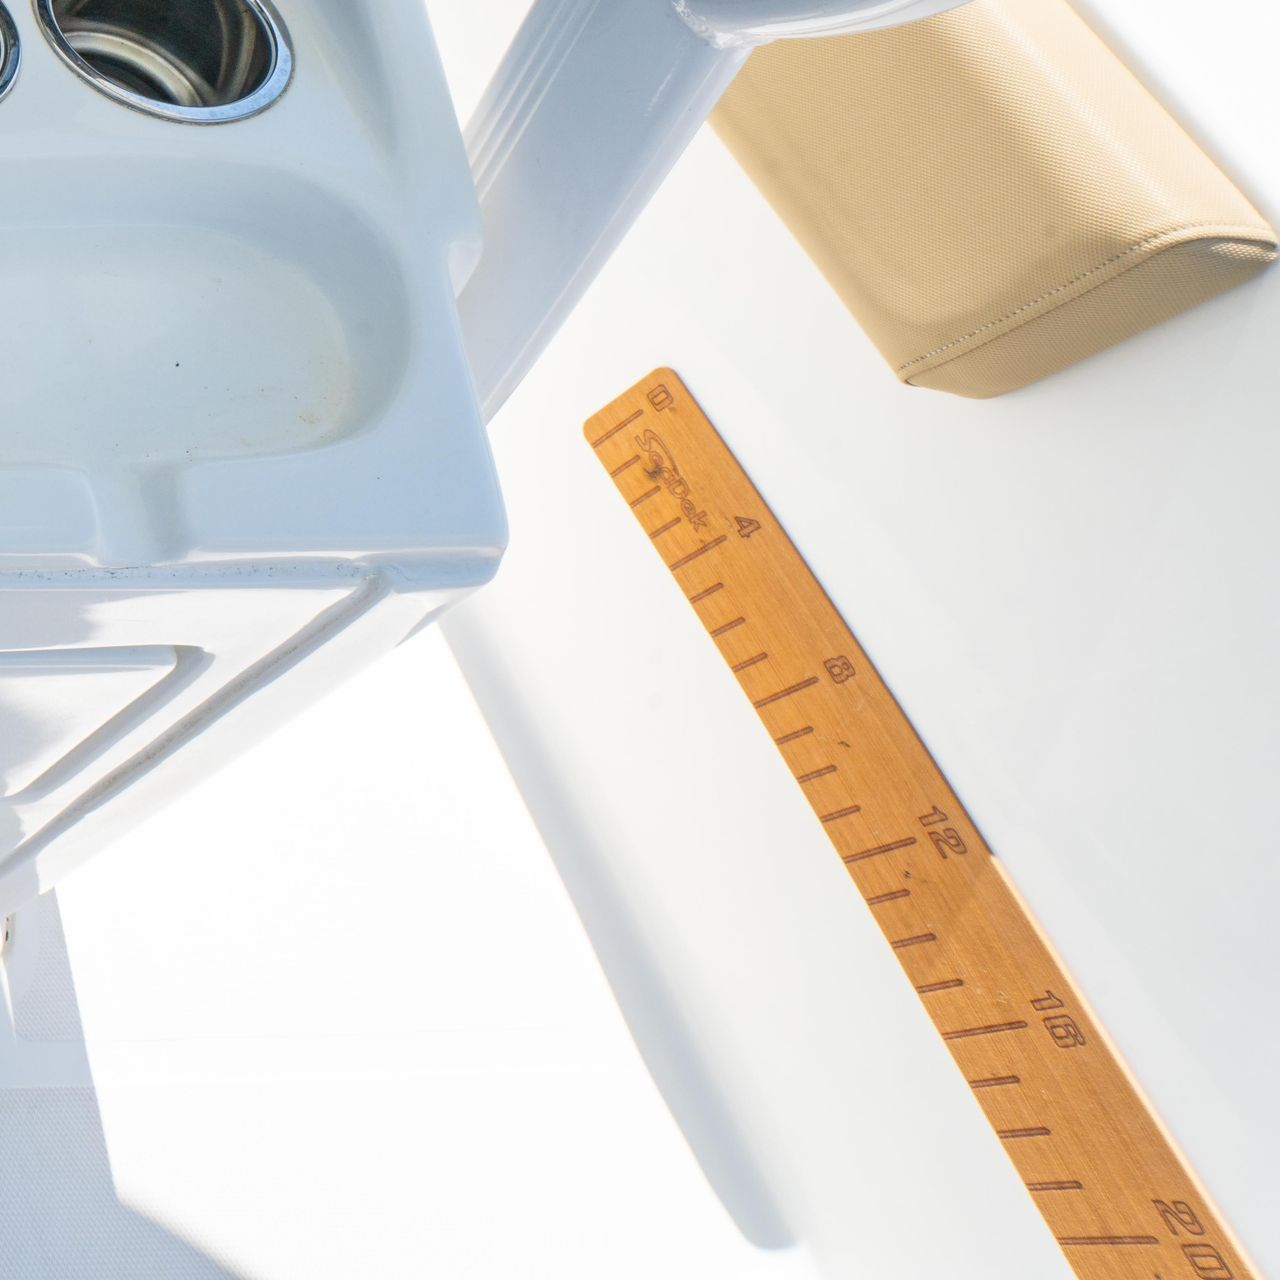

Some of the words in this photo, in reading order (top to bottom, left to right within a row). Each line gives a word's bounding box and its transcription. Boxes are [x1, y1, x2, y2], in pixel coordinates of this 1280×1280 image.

[634, 428, 708, 533] SeaDek
[734, 516, 761, 539] 4
[823, 654, 856, 684] 8
[917, 805, 968, 860] 12
[1029, 989, 1086, 1049] 16
[1151, 1199, 1234, 1280] 20
